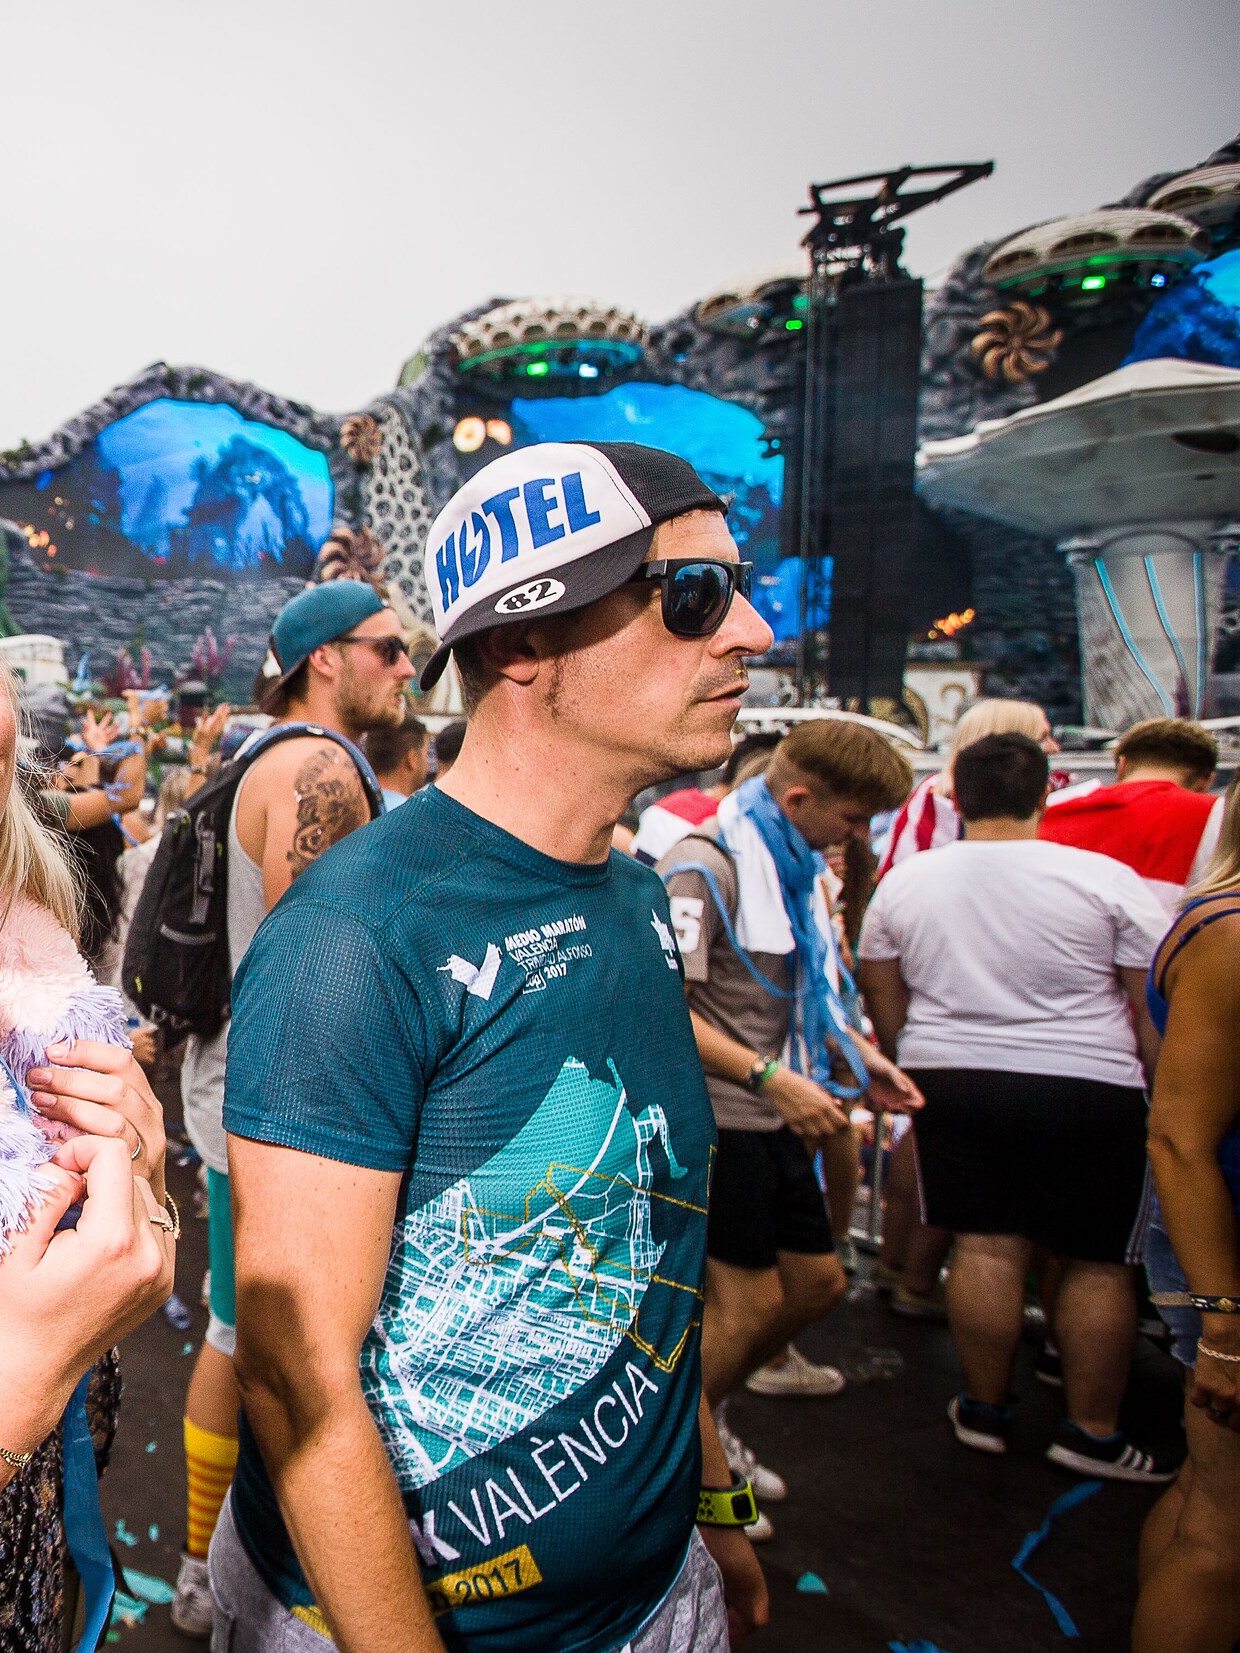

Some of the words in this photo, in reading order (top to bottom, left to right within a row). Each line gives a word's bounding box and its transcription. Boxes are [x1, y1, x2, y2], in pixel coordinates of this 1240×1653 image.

[436, 472, 600, 614] HOTEL
[503, 581, 557, 610] 82
[504, 929, 541, 952] MEDIO
[540, 913, 587, 938] MARATÓN
[543, 962, 567, 979] 2017
[557, 943, 593, 962] ALFONSO
[447, 1361, 659, 1546] VALÈNCIA
[455, 1557, 523, 1604] 2017
